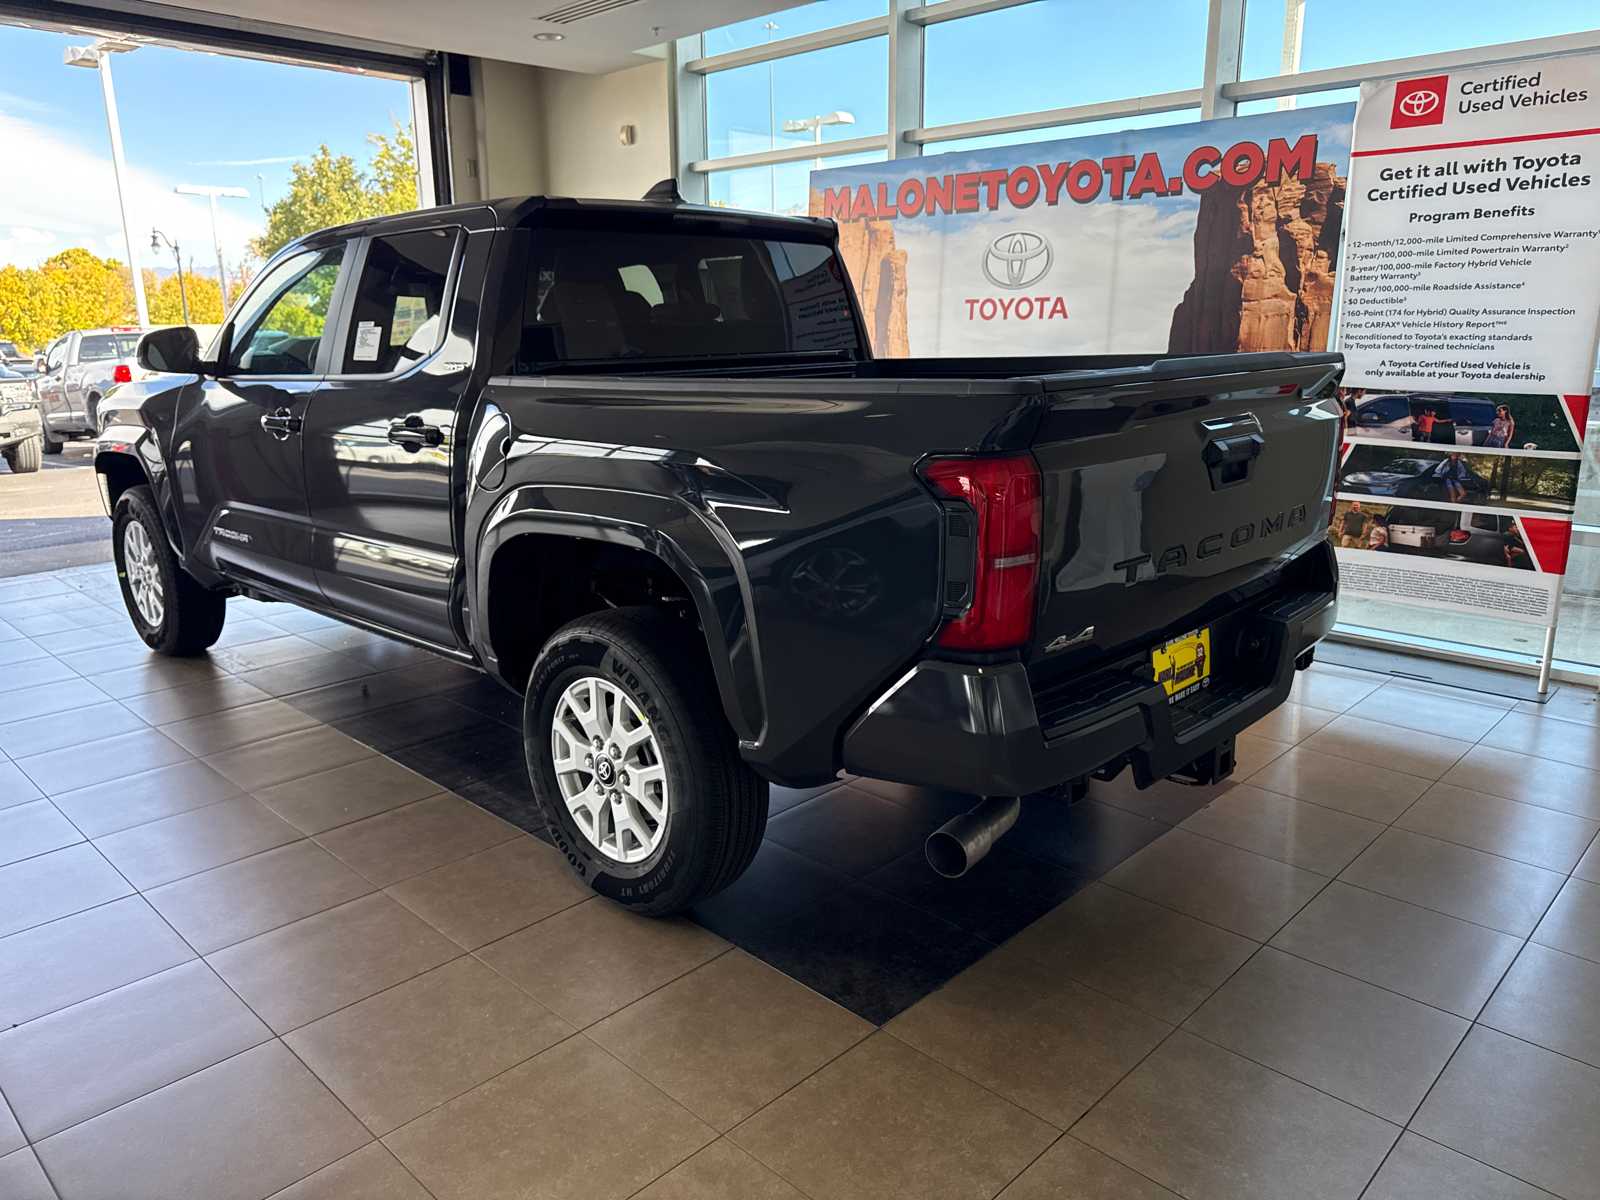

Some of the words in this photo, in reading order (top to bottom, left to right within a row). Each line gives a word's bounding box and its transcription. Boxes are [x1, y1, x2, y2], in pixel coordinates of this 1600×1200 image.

[1460, 72, 1541, 96] Certified
[1458, 95, 1504, 114] Used
[1509, 88, 1588, 109] Vehicles
[1379, 167, 1412, 182] Get
[1417, 164, 1431, 179] it
[1434, 161, 1459, 177] all
[1463, 158, 1507, 174] with
[1512, 152, 1582, 172] Toyota
[823, 134, 1318, 222] MALONETOYOTA.COM
[1367, 182, 1447, 202] Certified
[1452, 178, 1501, 195] Used
[1505, 172, 1592, 191] Vehicles
[1409, 210, 1470, 224] Program
[1473, 205, 1536, 220] Benefits
[1352, 236, 1444, 249] 12-month/12,000-mile
[1446, 234, 1479, 243] Limited
[1480, 231, 1552, 242] Comprehensive
[1352, 249, 1435, 261] 7-year/100,000-mile
[1436, 248, 1469, 256] Limited
[1471, 245, 1520, 255] Powertrain
[1350, 261, 1433, 273] 8-year/100,000-mile
[1434, 261, 1466, 270] Factory
[1467, 259, 1497, 269] Hybrid
[1499, 258, 1532, 267] Vehicle
[1349, 273, 1378, 282] Battery
[1349, 283, 1431, 295] 7-year/100,000-mile
[1433, 283, 1472, 291] Roadside
[964, 296, 1069, 324] TOYOTA
[1347, 309, 1384, 317] 160-Point
[1385, 308, 1402, 317] (174
[1403, 308, 1415, 316] for
[1416, 308, 1447, 317] Hybrid)
[1449, 308, 1481, 317] Quality
[1481, 308, 1526, 316] Assurance
[1528, 307, 1576, 317] Inspection
[1433, 320, 1464, 329] History
[1414, 333, 1447, 342] Toyota's
[1449, 334, 1486, 342] exacting
[1488, 333, 1533, 341] standards
[1344, 343, 1354, 351] by
[1355, 343, 1381, 351] Toyota
[1382, 343, 1444, 351] factory-trained
[1446, 343, 1495, 351] technicians
[1388, 360, 1417, 369] Toyota
[1419, 360, 1459, 368] Certified
[1460, 361, 1484, 369] Used
[1486, 361, 1521, 370] Vehicle
[1522, 362, 1531, 370] is
[1365, 369, 1384, 377] only
[1385, 369, 1425, 378] available
[1438, 371, 1459, 379] your
[1460, 371, 1492, 380] Toyota
[1493, 372, 1546, 382] dealership
[1113, 503, 1307, 587] TACOMA
[638, 850, 676, 895] TERRITORY
[621, 887, 633, 897] HT
